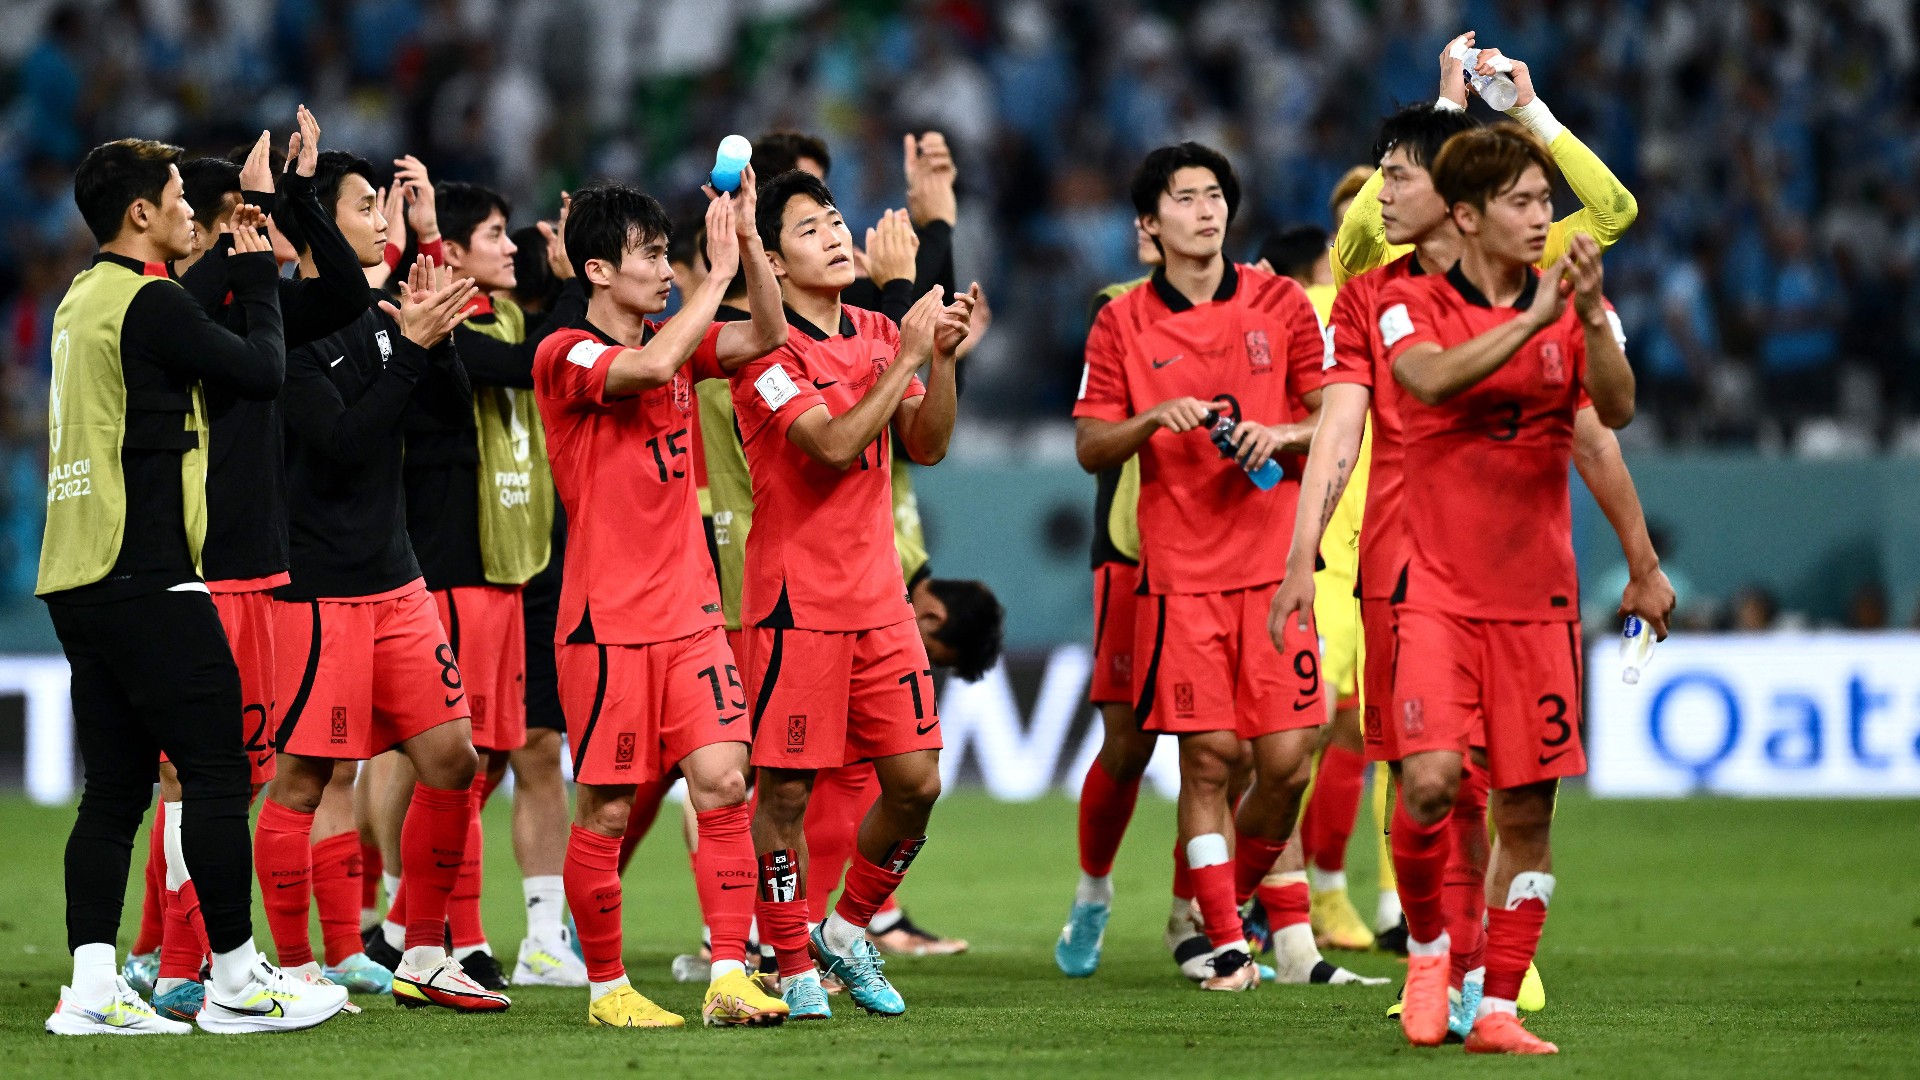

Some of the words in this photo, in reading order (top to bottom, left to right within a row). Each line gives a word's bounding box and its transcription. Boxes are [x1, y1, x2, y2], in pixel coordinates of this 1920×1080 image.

[645, 427, 688, 483] 15
[56, 477, 91, 501] 2022
[435, 643, 462, 690] 8
[697, 664, 747, 711] 15
[1293, 649, 1319, 696] 9
[243, 700, 276, 750] 2
[1537, 693, 1572, 747] 3
[1646, 667, 1920, 796] Qat
[595, 889, 622, 901] KOR
[716, 870, 757, 879] KOREA
[767, 872, 798, 903] 17
